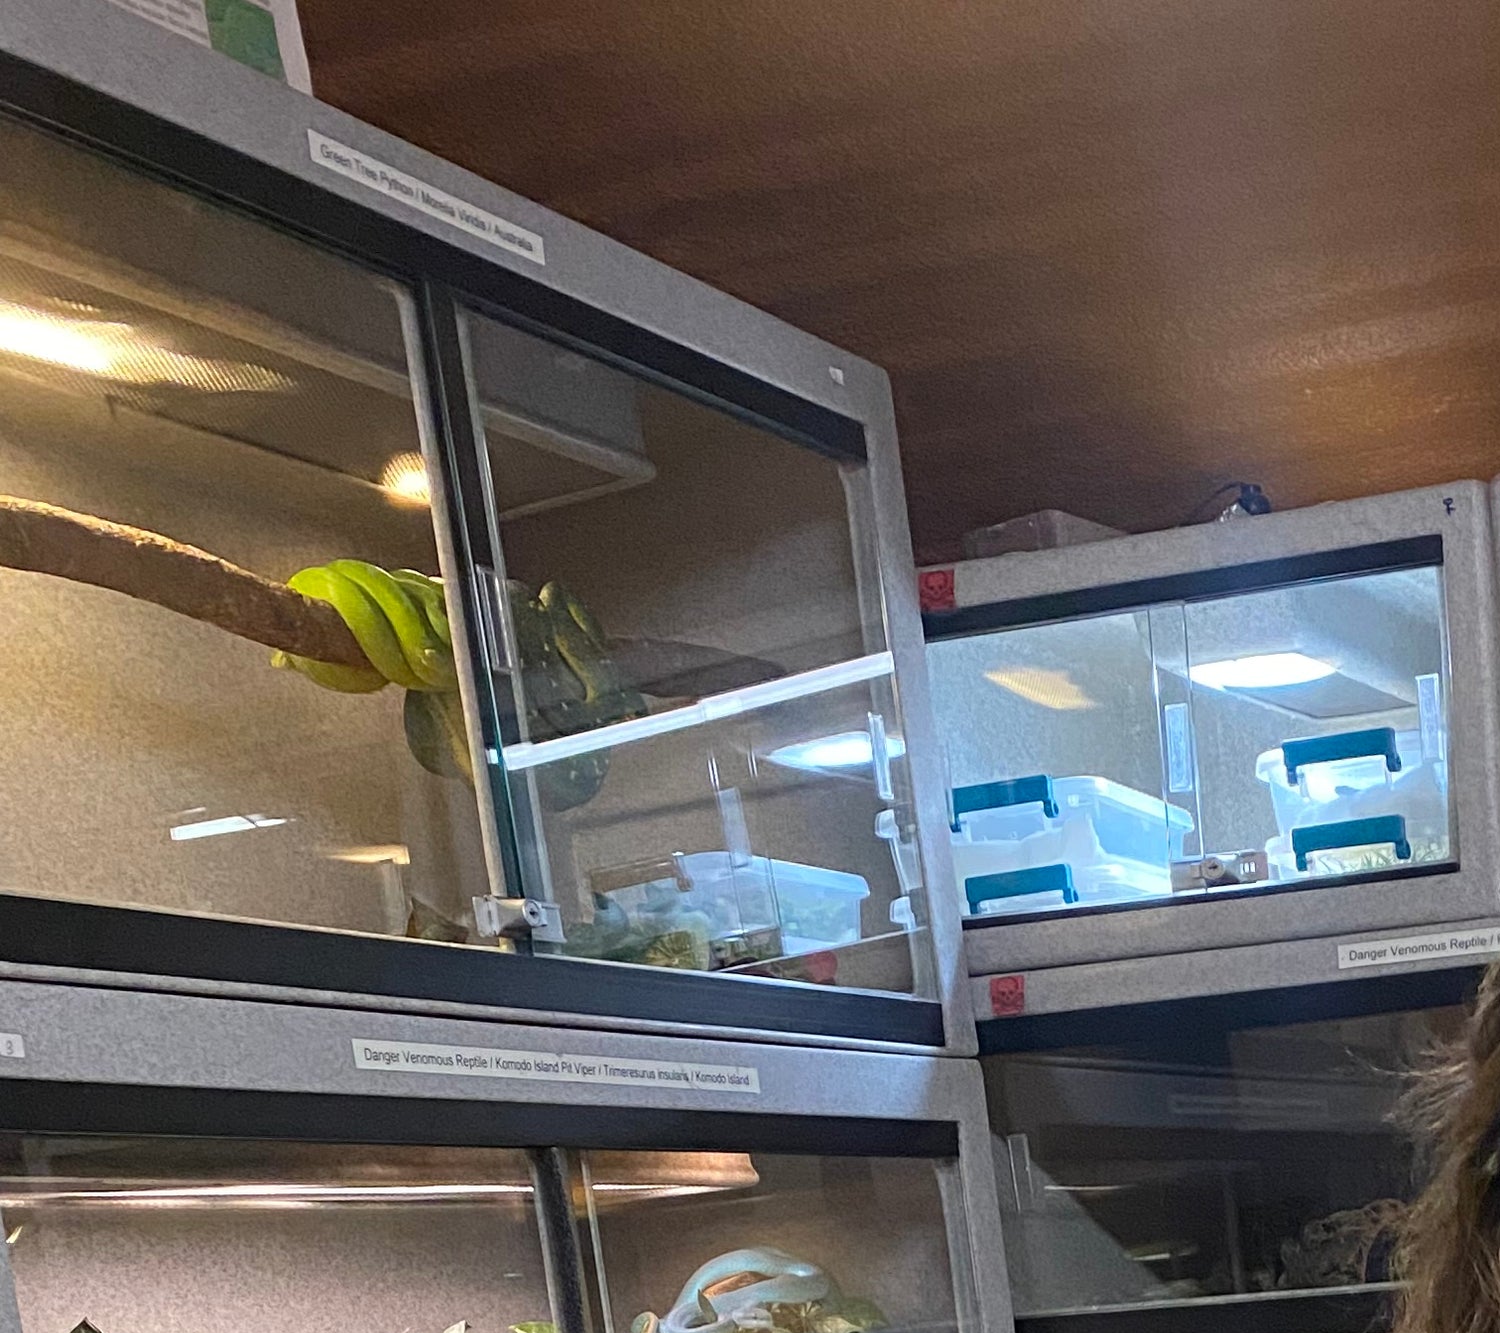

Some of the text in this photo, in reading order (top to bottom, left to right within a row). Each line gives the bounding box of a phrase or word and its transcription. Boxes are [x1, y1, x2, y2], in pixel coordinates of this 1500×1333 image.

[320, 144, 350, 167] Green
[354, 158, 377, 181] Tree
[494, 224, 533, 252] Australia
[1349, 948, 1387, 962] Danger
[1390, 943, 1447, 957] Venomous
[1450, 936, 1487, 950] Reptile
[364, 1047, 400, 1065] Danger
[402, 1050, 453, 1067] Venomous
[455, 1054, 488, 1069] Reptile
[496, 1059, 532, 1071] Komodo
[534, 1059, 559, 1073] Island
[561, 1060, 573, 1073] Pit
[574, 1062, 596, 1077] Viper
[696, 1071, 726, 1084] Komodo
[728, 1073, 750, 1086] Island
